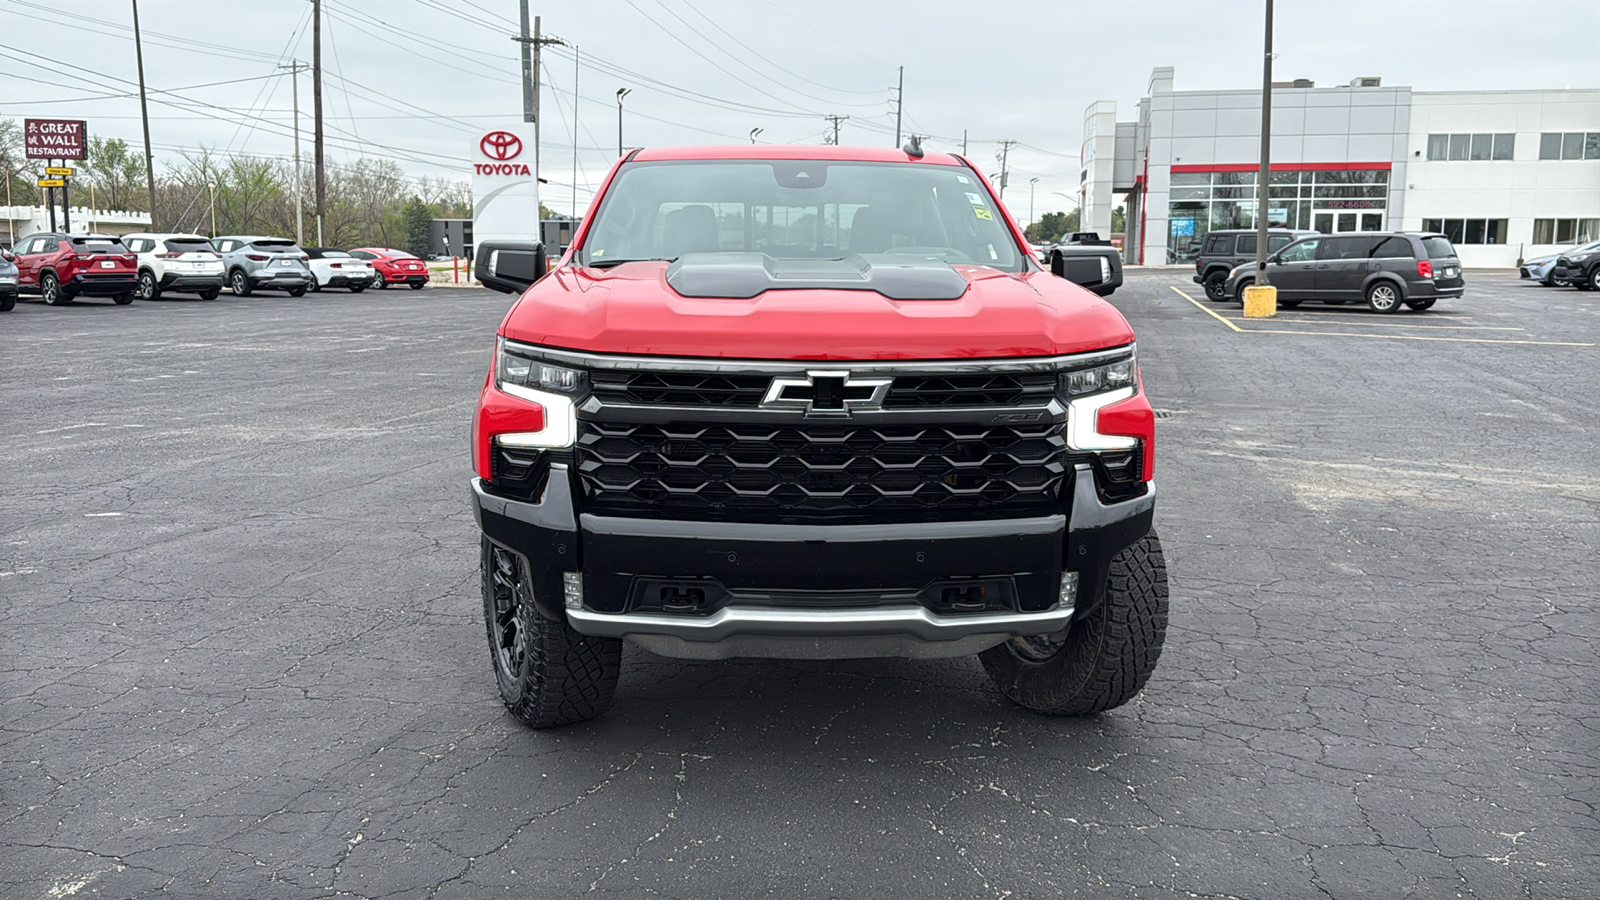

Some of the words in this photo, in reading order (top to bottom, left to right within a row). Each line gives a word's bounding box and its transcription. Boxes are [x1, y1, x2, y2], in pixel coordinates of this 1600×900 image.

[40, 123, 79, 134] GREAT
[41, 135, 78, 146] WALL
[28, 147, 81, 156] RESTAURANT
[474, 164, 531, 176] TOYOTA
